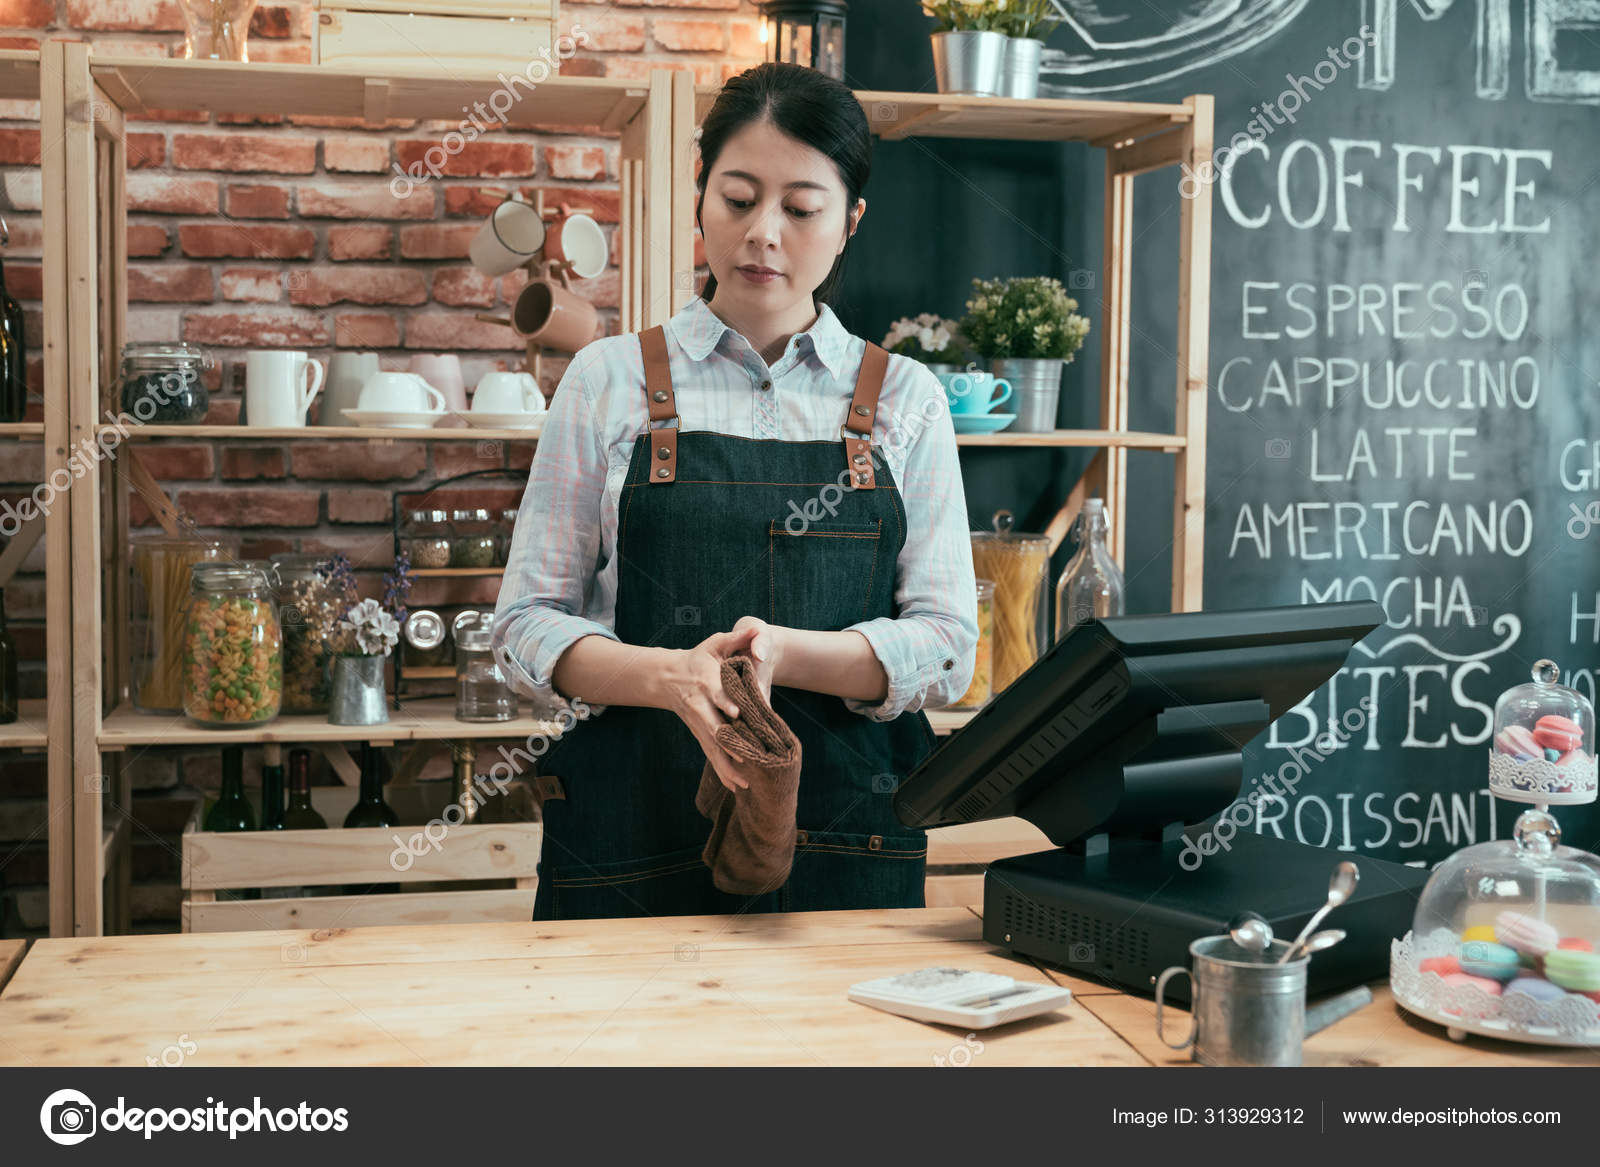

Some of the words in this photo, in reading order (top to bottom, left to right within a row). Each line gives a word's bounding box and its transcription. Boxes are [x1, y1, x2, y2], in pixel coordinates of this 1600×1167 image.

[1219, 137, 1553, 235] COFFEE
[1242, 281, 1529, 341] ESPRESSO
[1217, 356, 1540, 412] CAPPUCCINO
[1309, 427, 1477, 481] LATTE
[1229, 498, 1533, 560] AMERICANO
[1264, 660, 1495, 751] BITES
